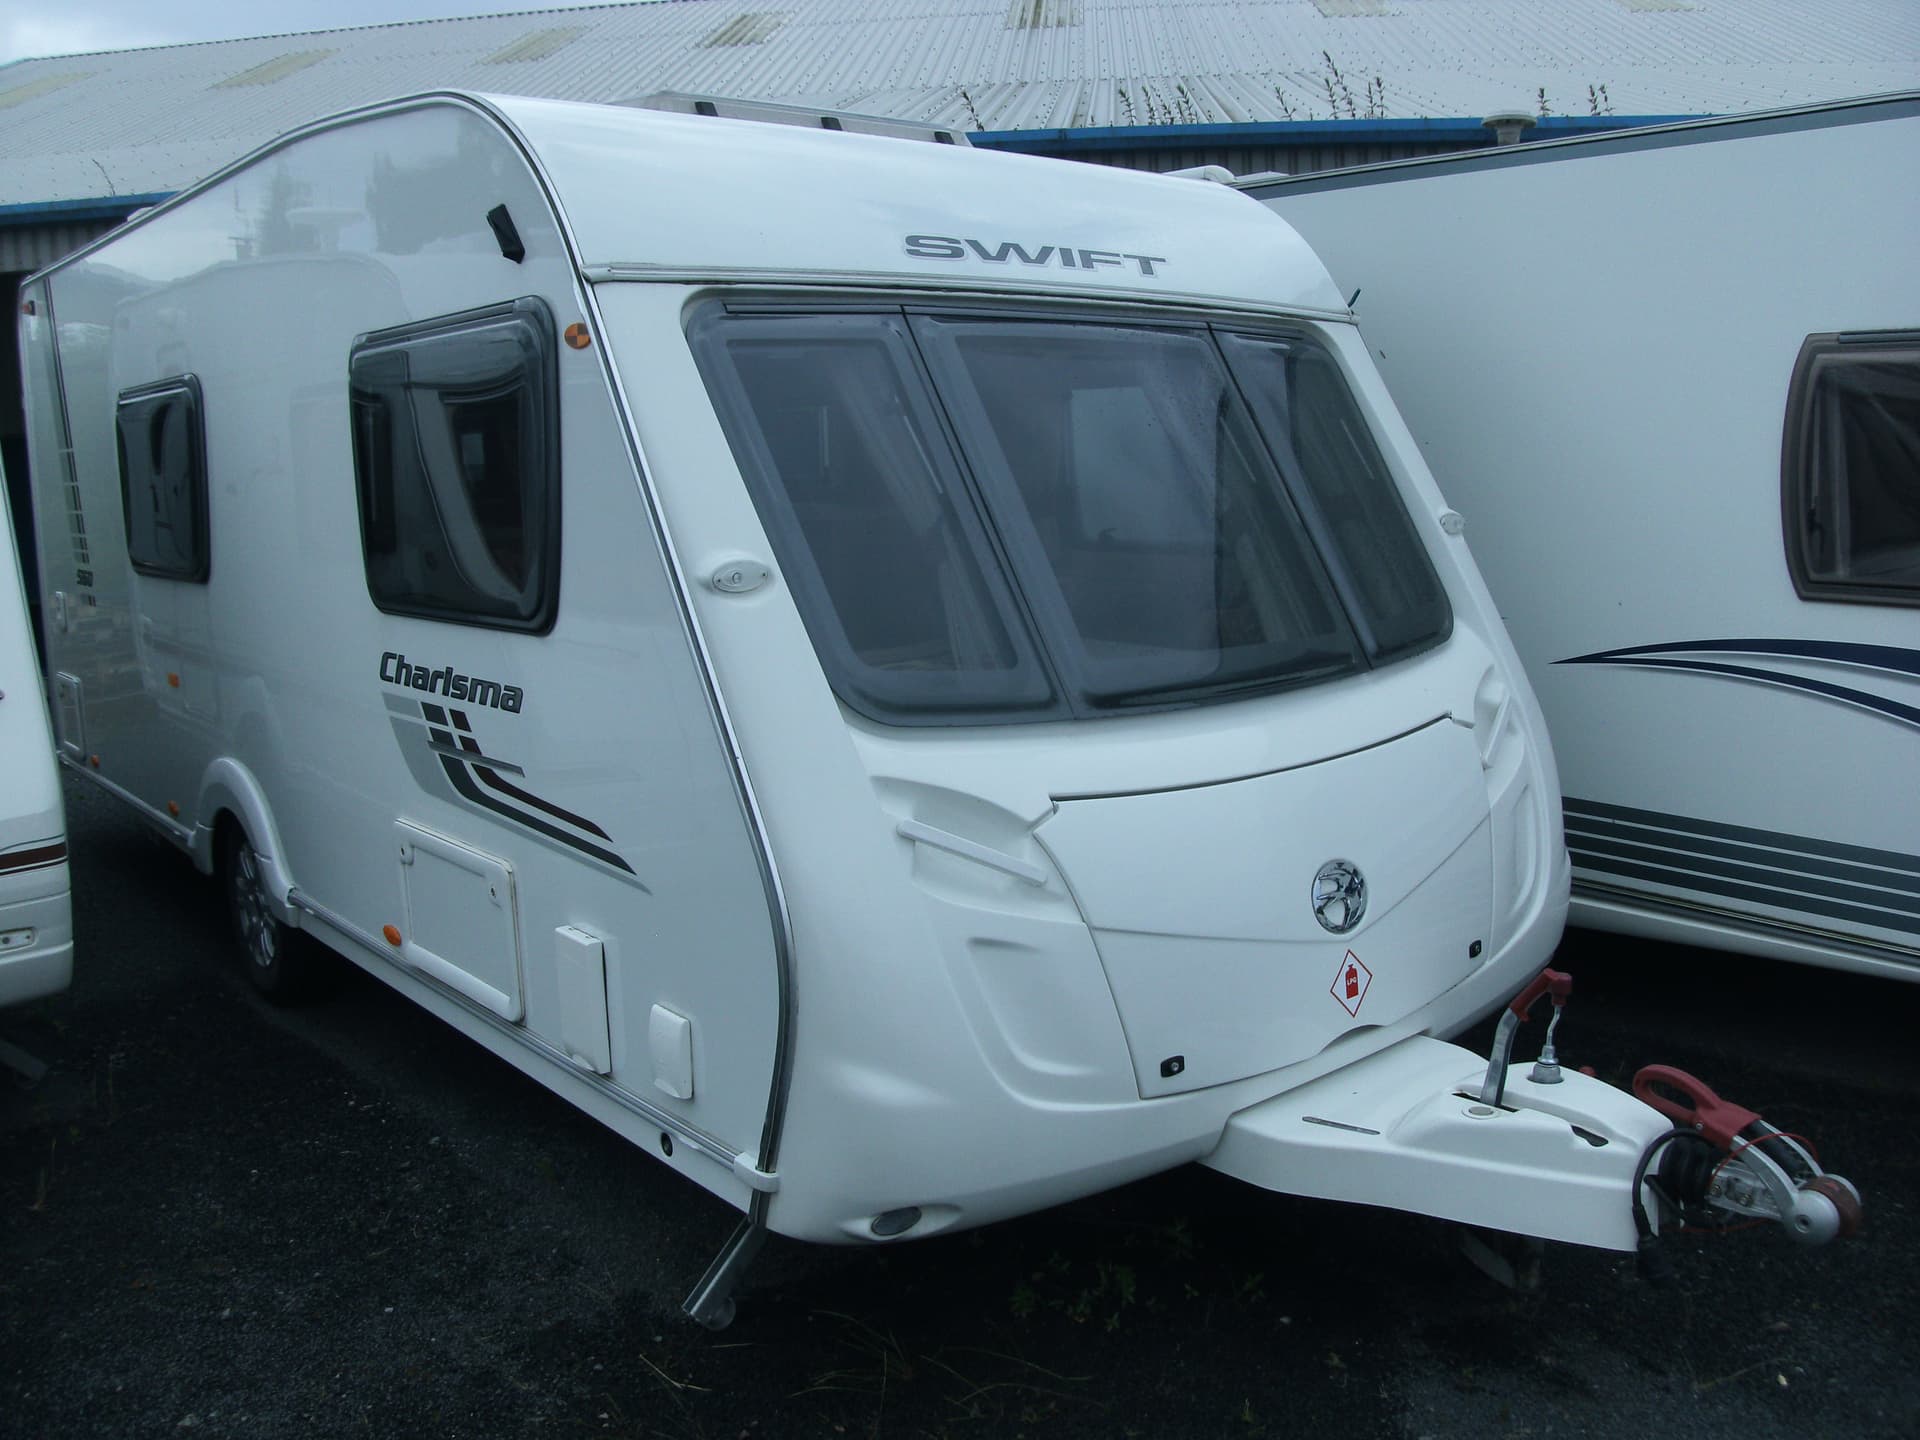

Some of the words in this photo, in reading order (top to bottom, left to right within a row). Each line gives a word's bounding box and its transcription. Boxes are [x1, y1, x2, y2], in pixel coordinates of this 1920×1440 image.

[905, 235, 1166, 276] SWIFT
[379, 651, 524, 714] Charisma
[1346, 976, 1357, 986] LPG
